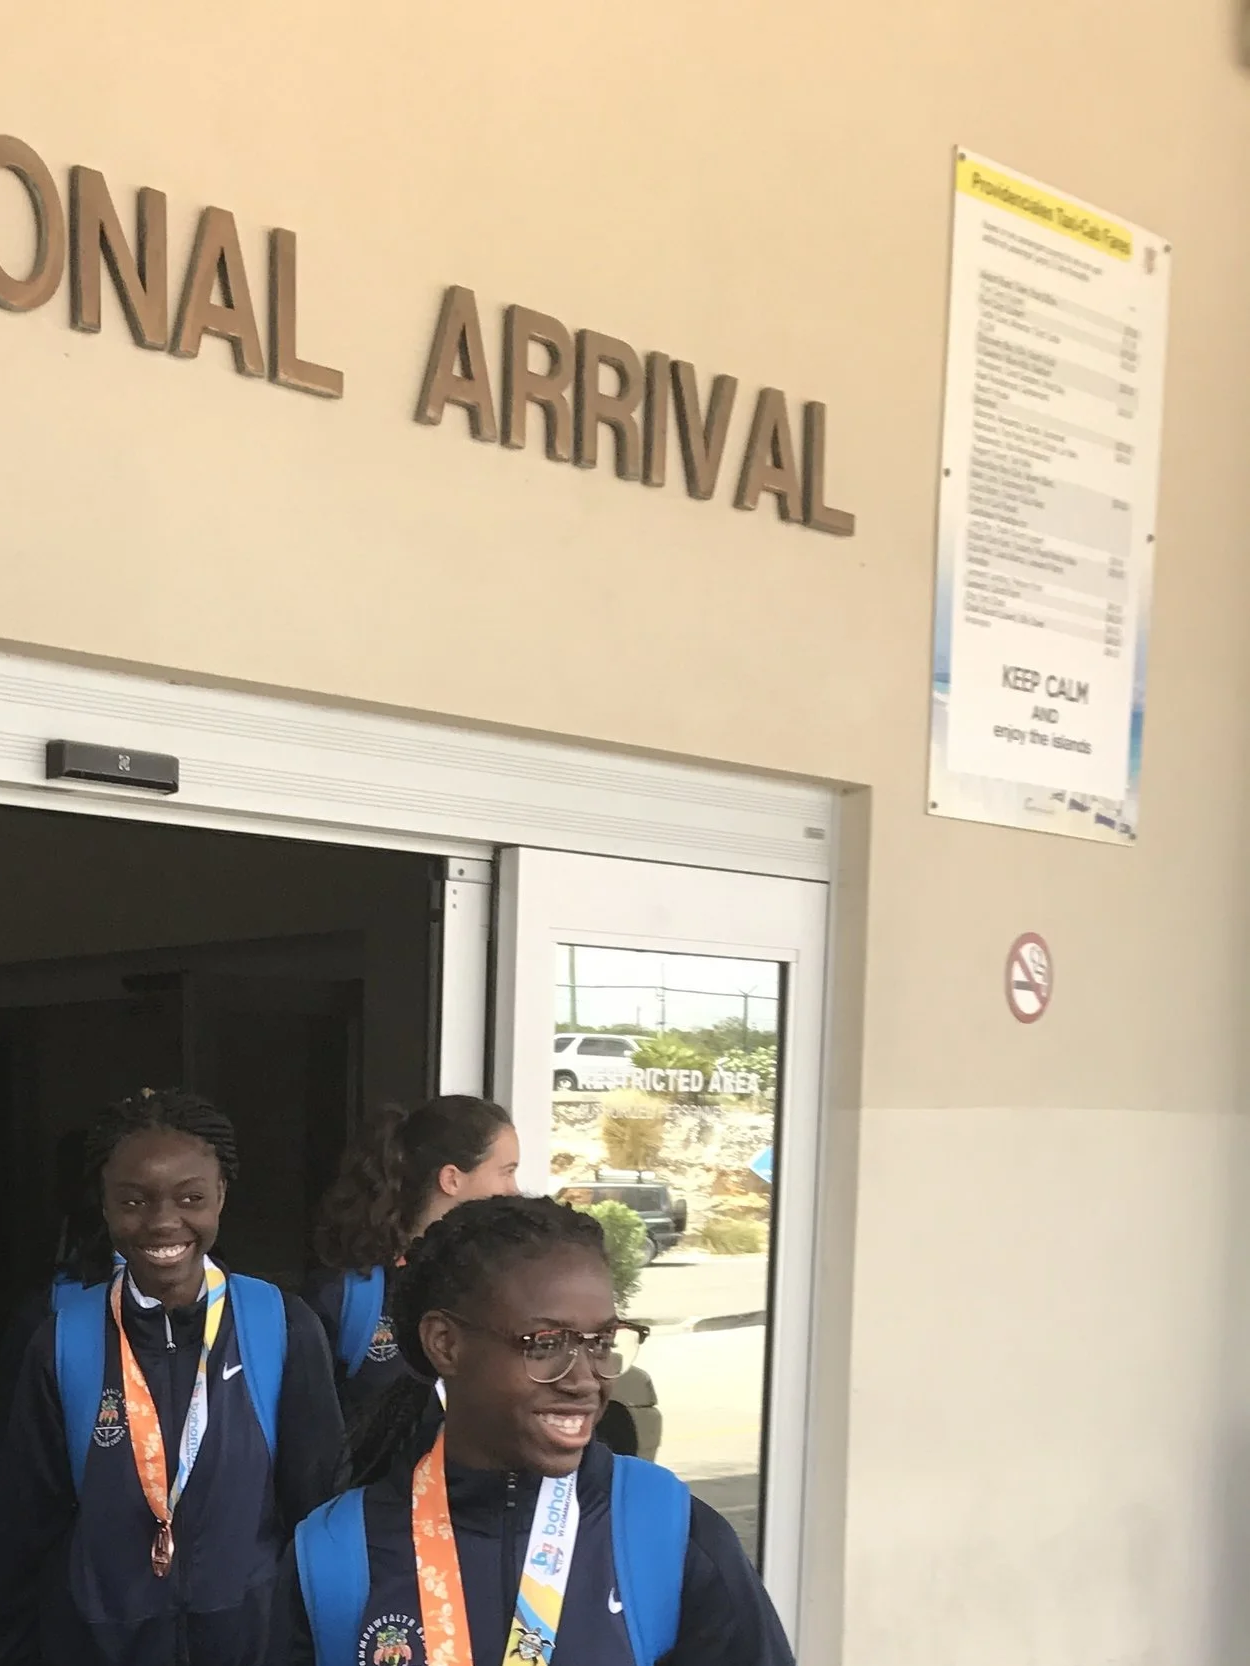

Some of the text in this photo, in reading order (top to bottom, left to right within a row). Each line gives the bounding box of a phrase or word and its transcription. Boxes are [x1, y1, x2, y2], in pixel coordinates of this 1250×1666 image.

[413, 284, 856, 538] ARRIVAL
[1001, 663, 1090, 705] KEEP CALM
[1031, 705, 1060, 724] AND
[1029, 727, 1049, 747] the
[707, 1070, 761, 1096] AREA
